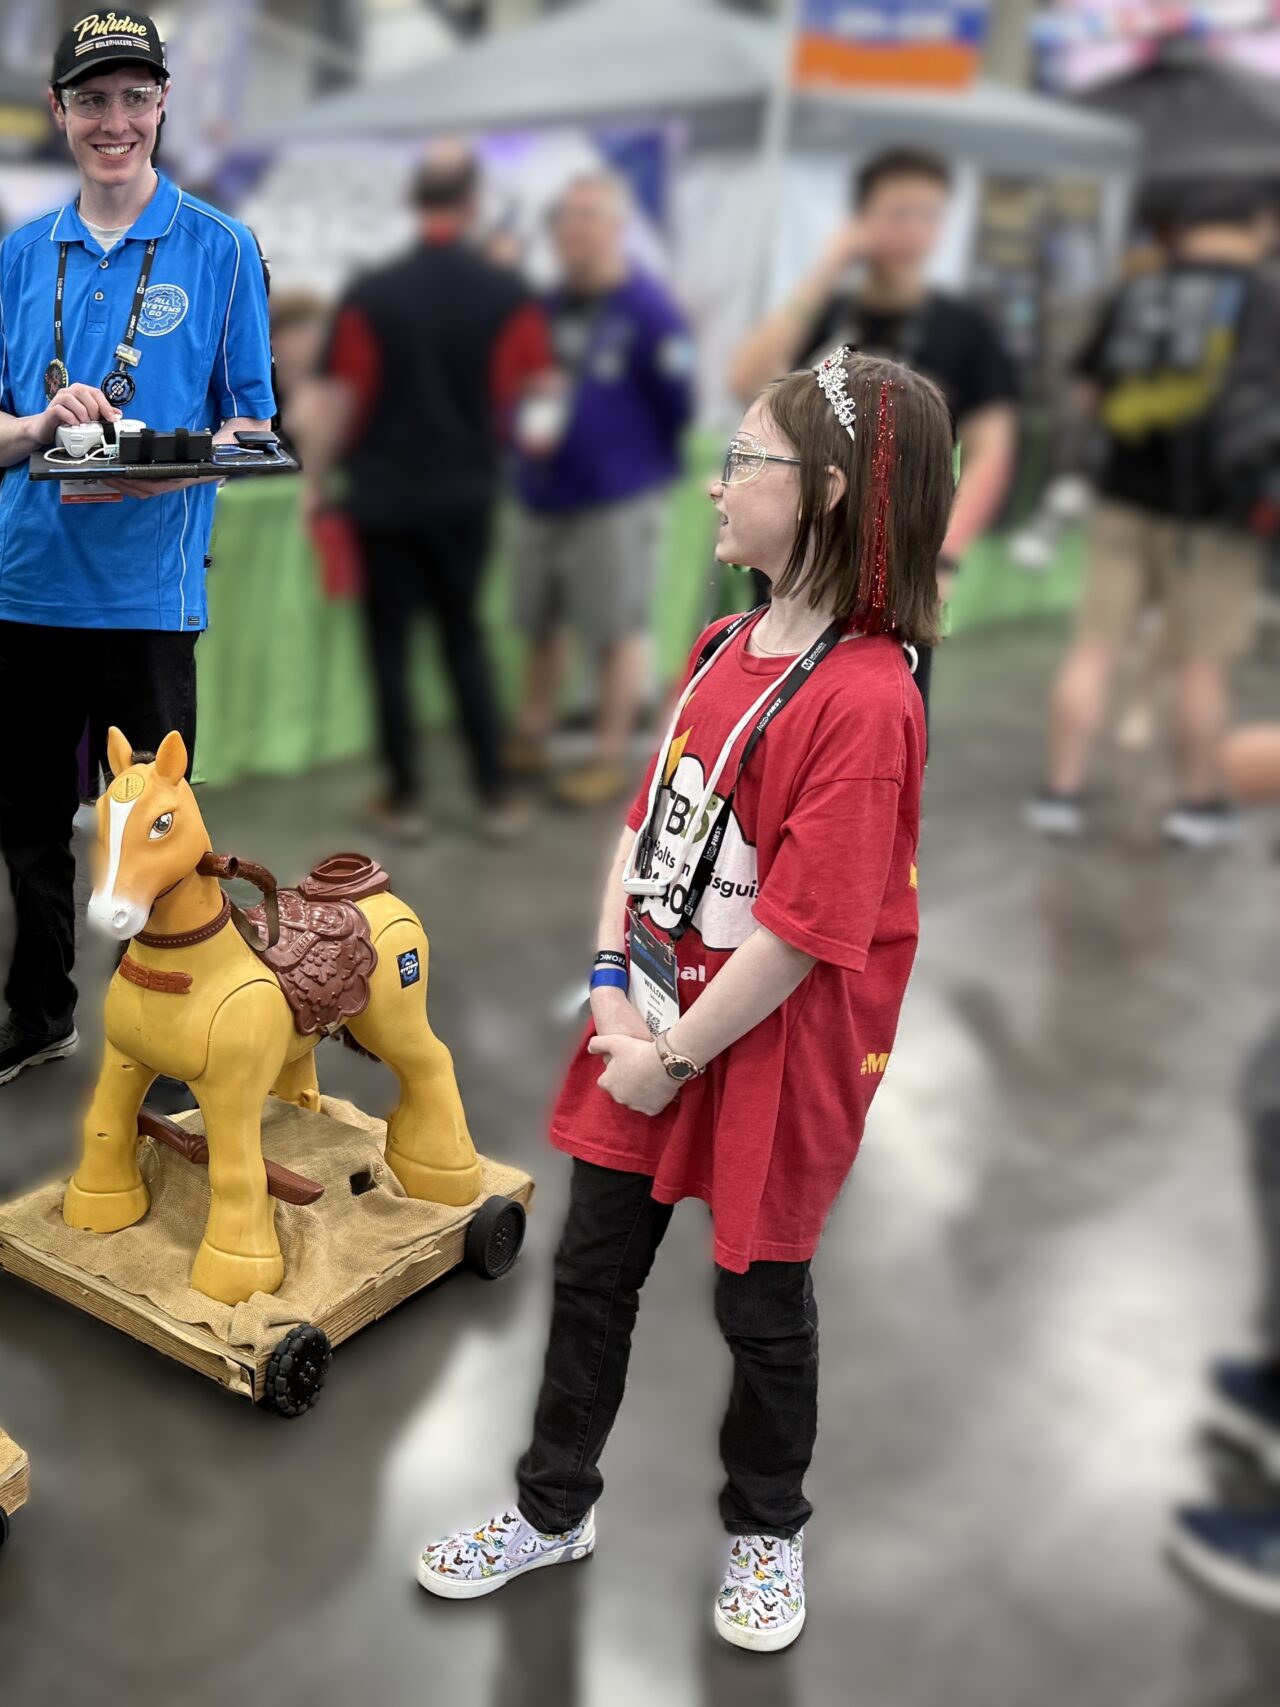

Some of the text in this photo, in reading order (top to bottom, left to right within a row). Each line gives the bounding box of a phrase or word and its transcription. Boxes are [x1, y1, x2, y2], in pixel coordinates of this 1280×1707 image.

[73, 12, 148, 41] Purdue
[141, 301, 182, 313] SYSTEMS
[154, 297, 171, 306] ALL
[766, 697, 784, 718] FIRST
[712, 825, 723, 847] FIRST
[676, 964, 706, 982] al
